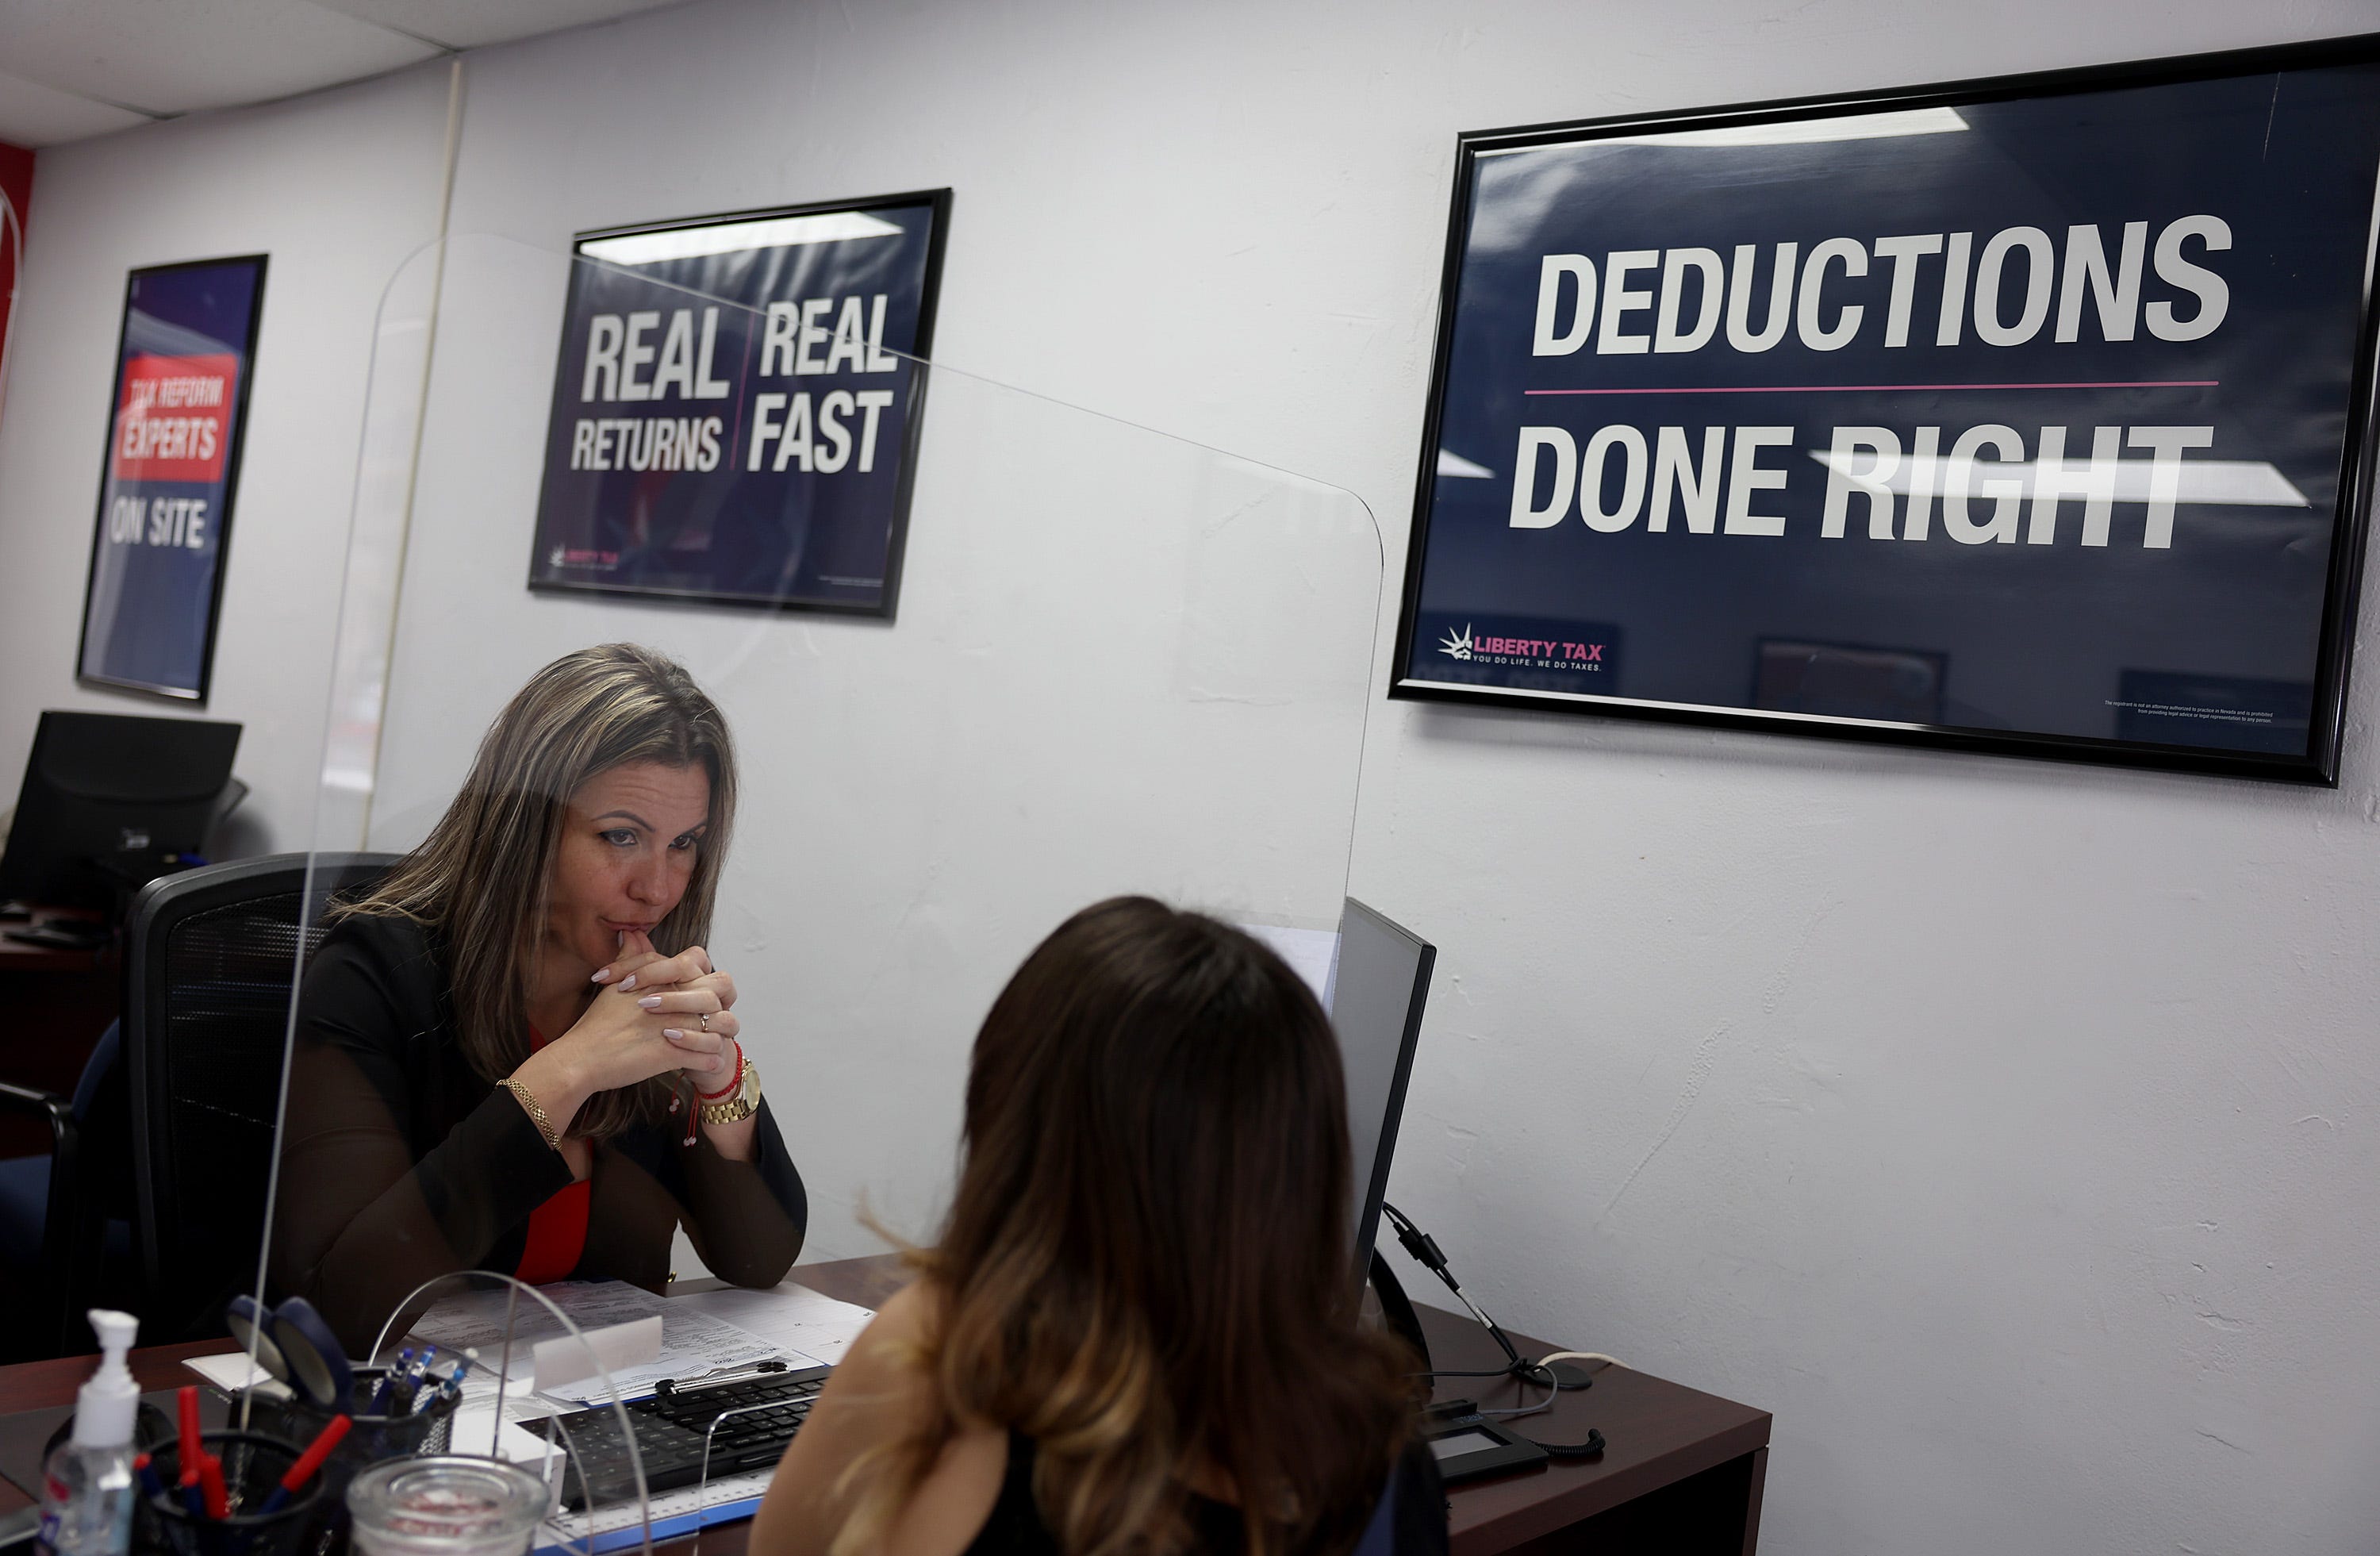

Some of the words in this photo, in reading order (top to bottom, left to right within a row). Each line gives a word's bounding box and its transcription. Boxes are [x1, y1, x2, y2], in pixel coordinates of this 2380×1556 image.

[1532, 214, 2232, 356] DEDUCTIONS
[581, 306, 731, 402] REAL
[758, 294, 899, 378] REAL
[159, 375, 225, 409] REFORM
[121, 416, 219, 462] EXPERTS
[570, 415, 724, 474] RETURNS
[747, 390, 895, 474] FAST
[1509, 425, 1795, 537] DONE
[1820, 425, 2214, 549] RIGHT
[109, 494, 148, 547] ON
[148, 495, 209, 549] SITE
[1473, 655, 1491, 663] YOU
[1511, 658, 1534, 667] LIFE.
[1571, 663, 1602, 672] TAXES.
[1474, 636, 1557, 659] LIBERTY
